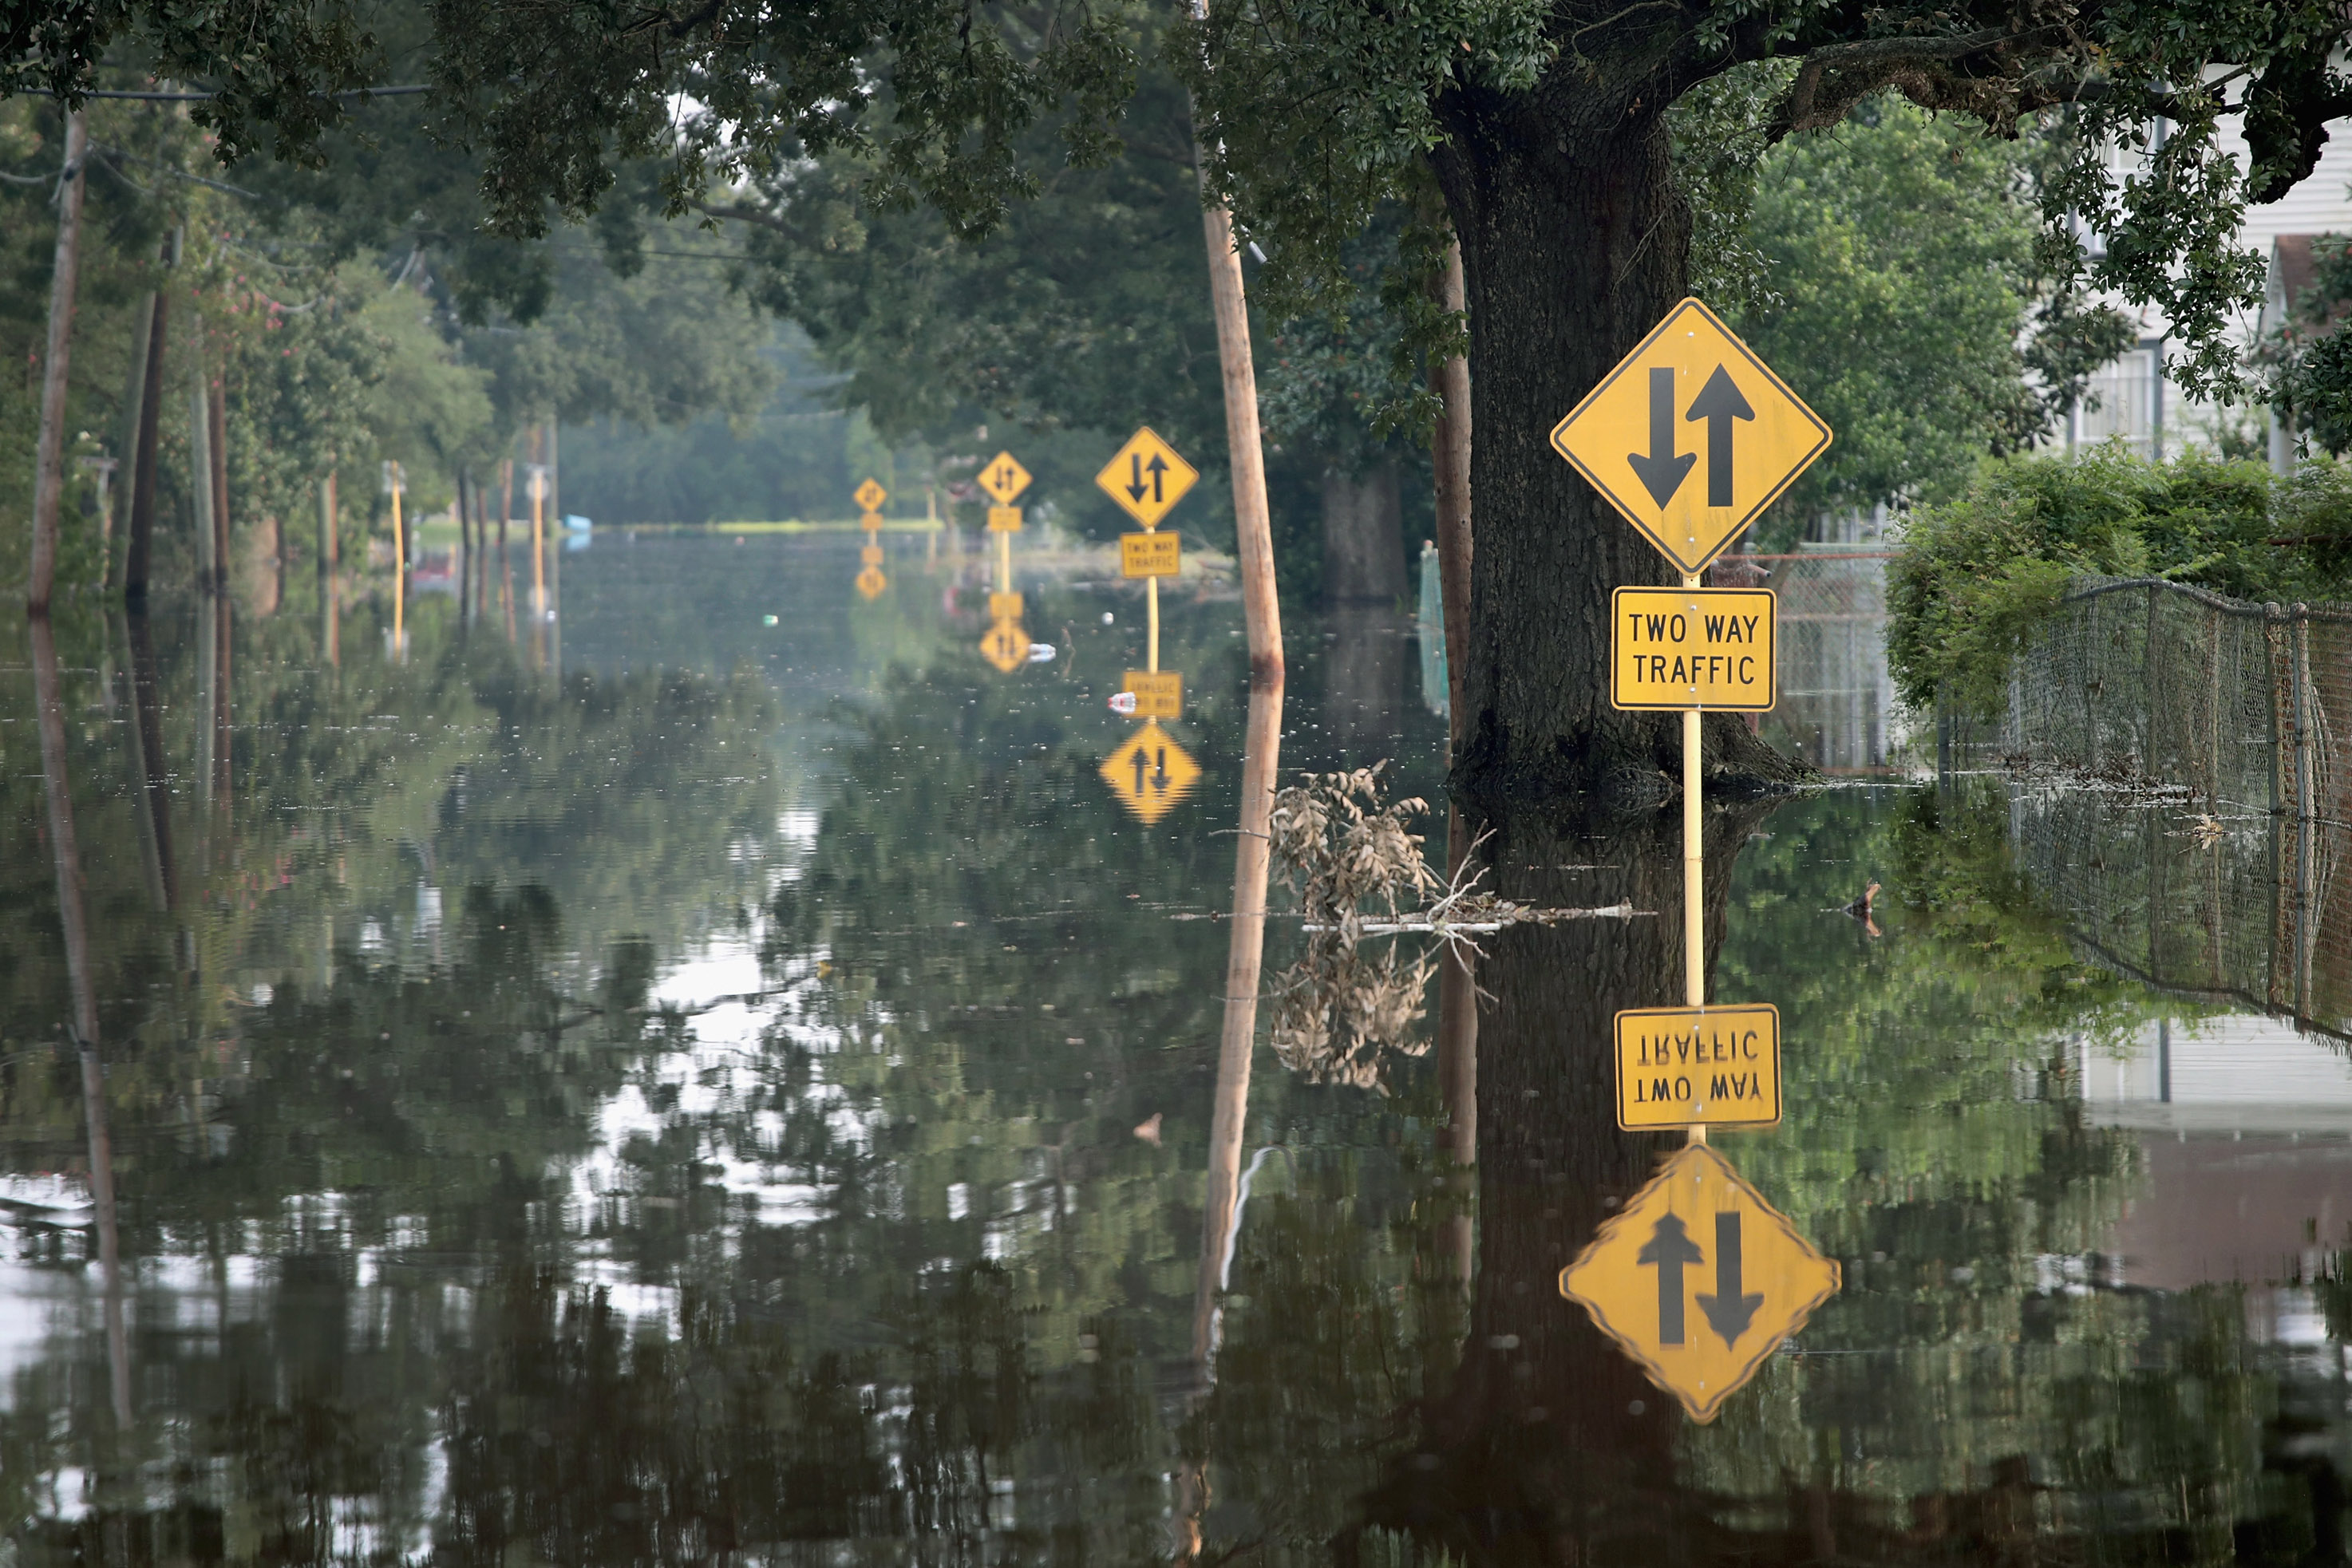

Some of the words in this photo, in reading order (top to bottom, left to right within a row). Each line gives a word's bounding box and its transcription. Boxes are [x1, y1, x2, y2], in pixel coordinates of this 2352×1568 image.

[1629, 614, 1686, 642] TWO
[1705, 614, 1759, 643] WAY
[1633, 655, 1754, 684] TRAFFIC
